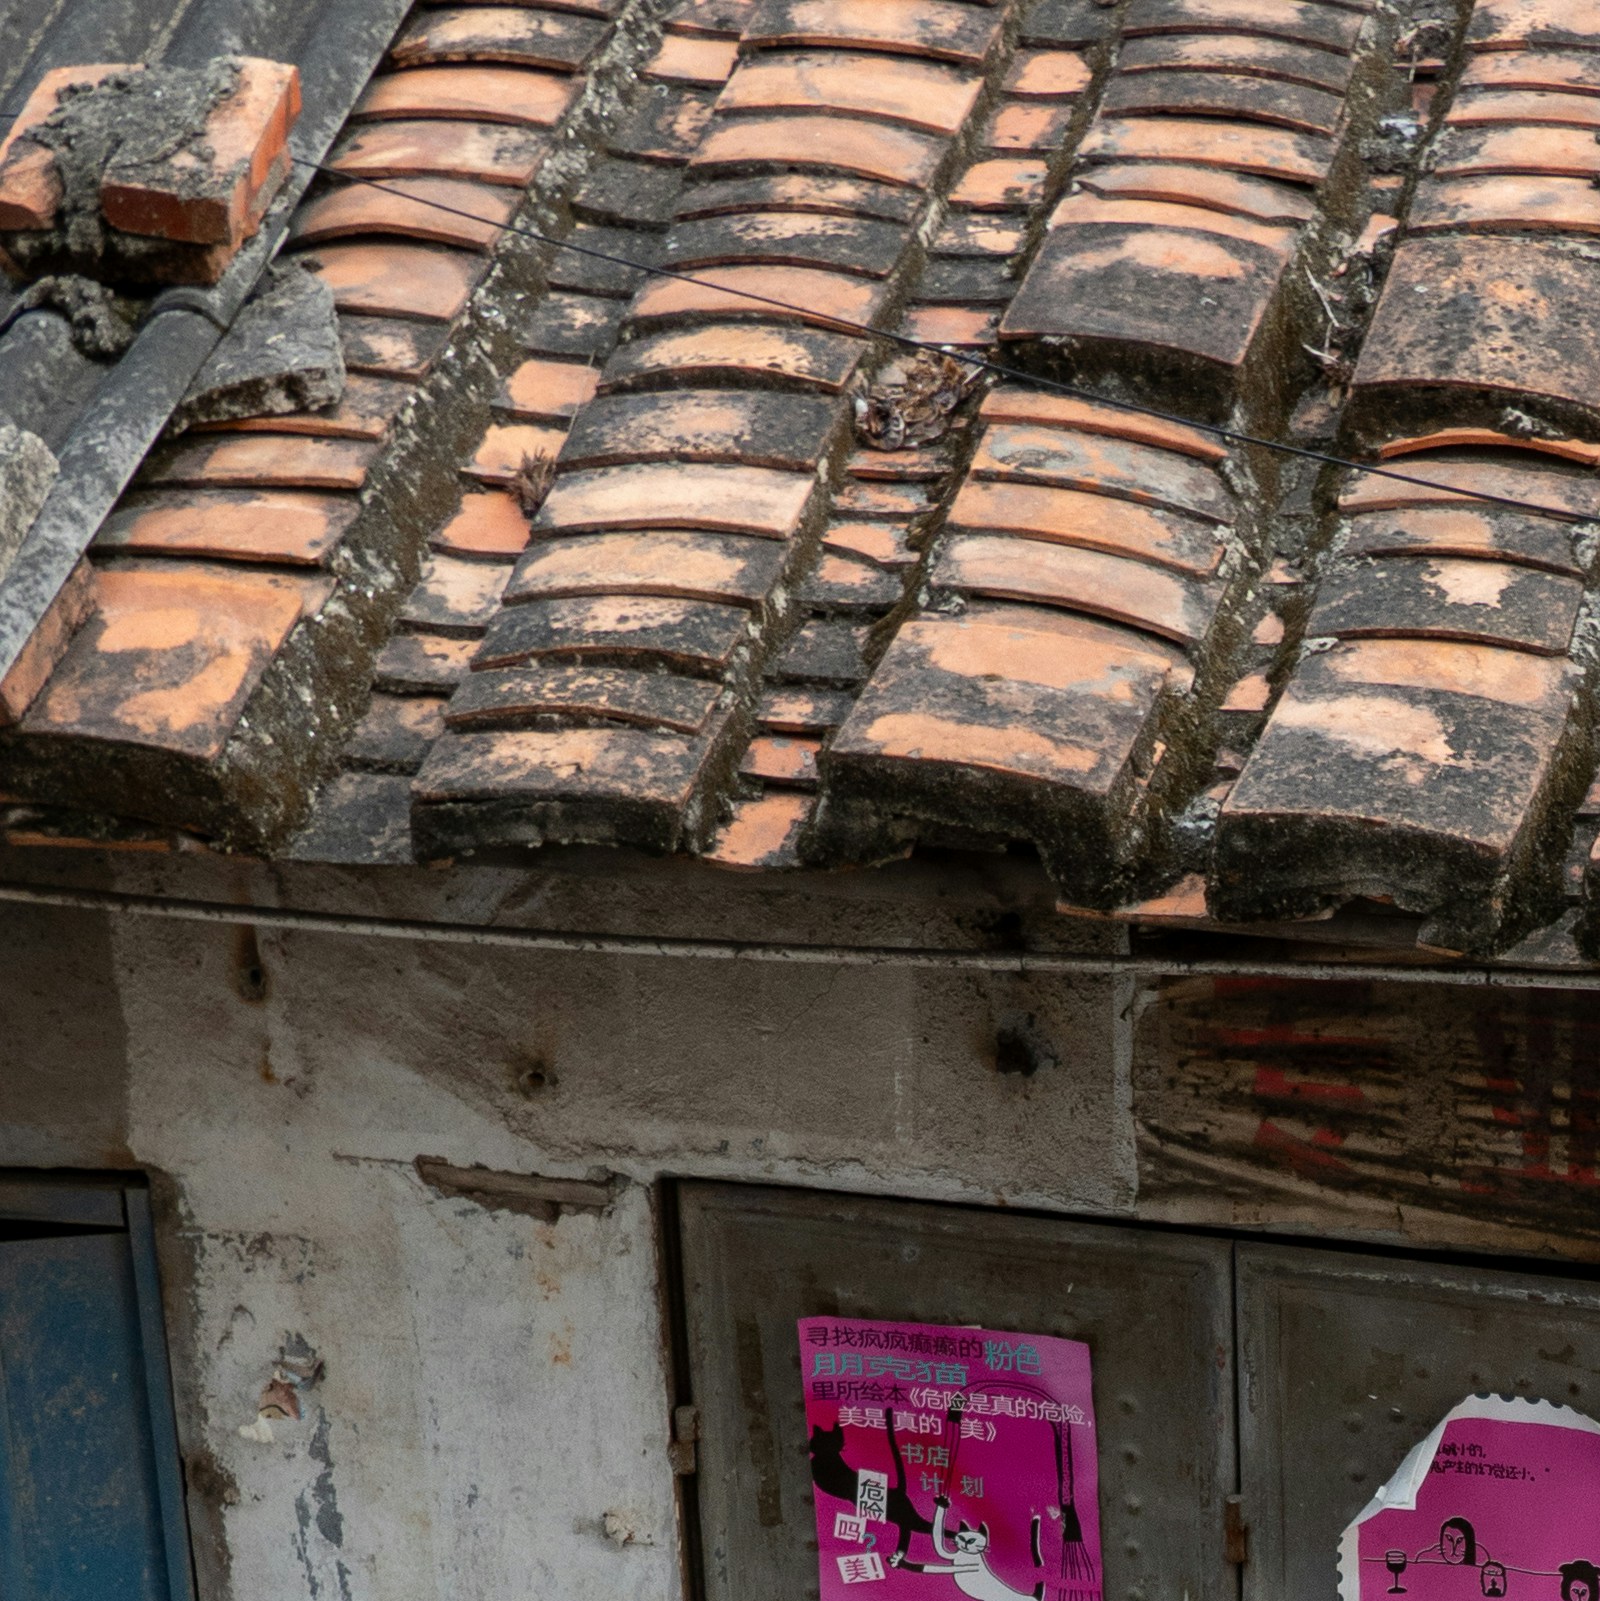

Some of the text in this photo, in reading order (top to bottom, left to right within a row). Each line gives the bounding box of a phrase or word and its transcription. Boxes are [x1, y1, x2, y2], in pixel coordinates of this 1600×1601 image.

[811, 1353, 970, 1387] 朋克猫
[900, 1442, 950, 1468] 书店
[859, 1478, 886, 1522] 危险
